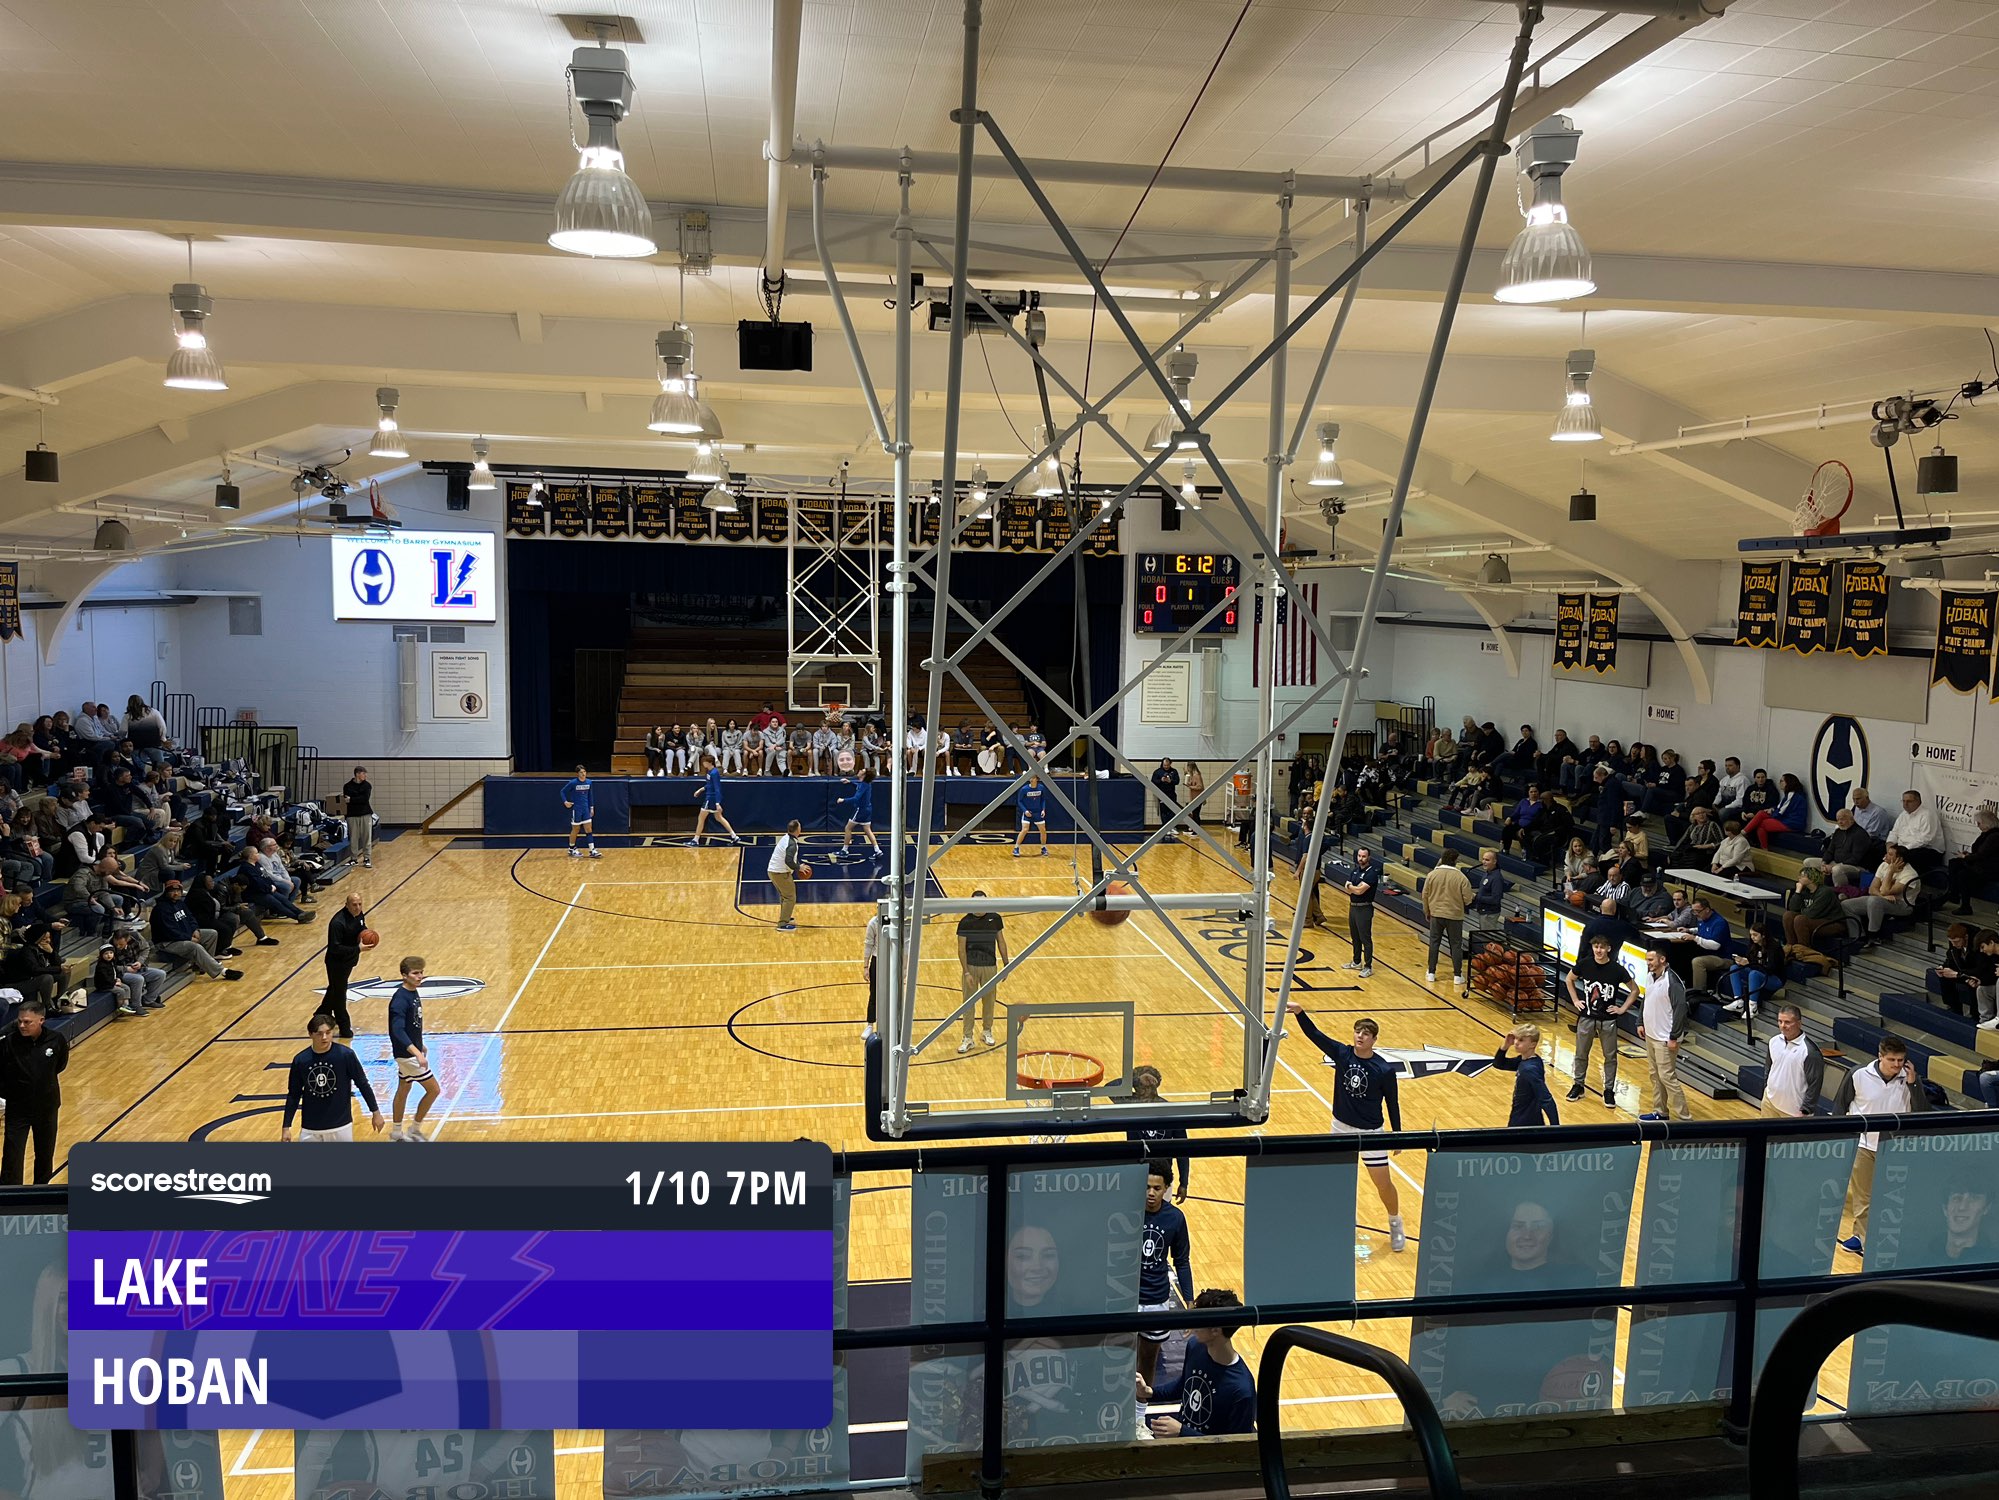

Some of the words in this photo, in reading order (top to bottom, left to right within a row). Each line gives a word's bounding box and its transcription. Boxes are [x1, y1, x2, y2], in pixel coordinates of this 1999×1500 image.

[761, 498, 788, 509] HOBAN
[802, 500, 829, 509] HOBAN
[403, 537, 430, 545] BARRY
[432, 538, 481, 546] GYMNASIUM
[1176, 555, 1213, 573] 6:12
[1141, 575, 1167, 584] HOBAN
[1211, 576, 1235, 584] GUEST
[1744, 575, 1778, 594] HOBAN
[1790, 575, 1829, 596] HOBAN
[1845, 574, 1887, 594] HOBAN
[1156, 585, 1166, 603] 0
[1188, 588, 1193, 601] 1
[1144, 610, 1152, 624] 0
[1225, 611, 1235, 624] 0
[1559, 606, 1583, 621] HOBAN
[1591, 607, 1617, 625] HOBAN
[1946, 606, 1988, 628] HOBAN
[1788, 616, 1802, 626] STATE
[1804, 618, 1827, 627] CHAMPS
[1952, 626, 1979, 636] WRESTLING
[1486, 643, 1499, 651] HOME
[1945, 635, 1962, 647] STATE
[1963, 638, 1986, 648] CHAMPS
[1656, 708, 1675, 720] HOME
[1926, 746, 1957, 761] HOME
[1936, 794, 1974, 818] Wentz
